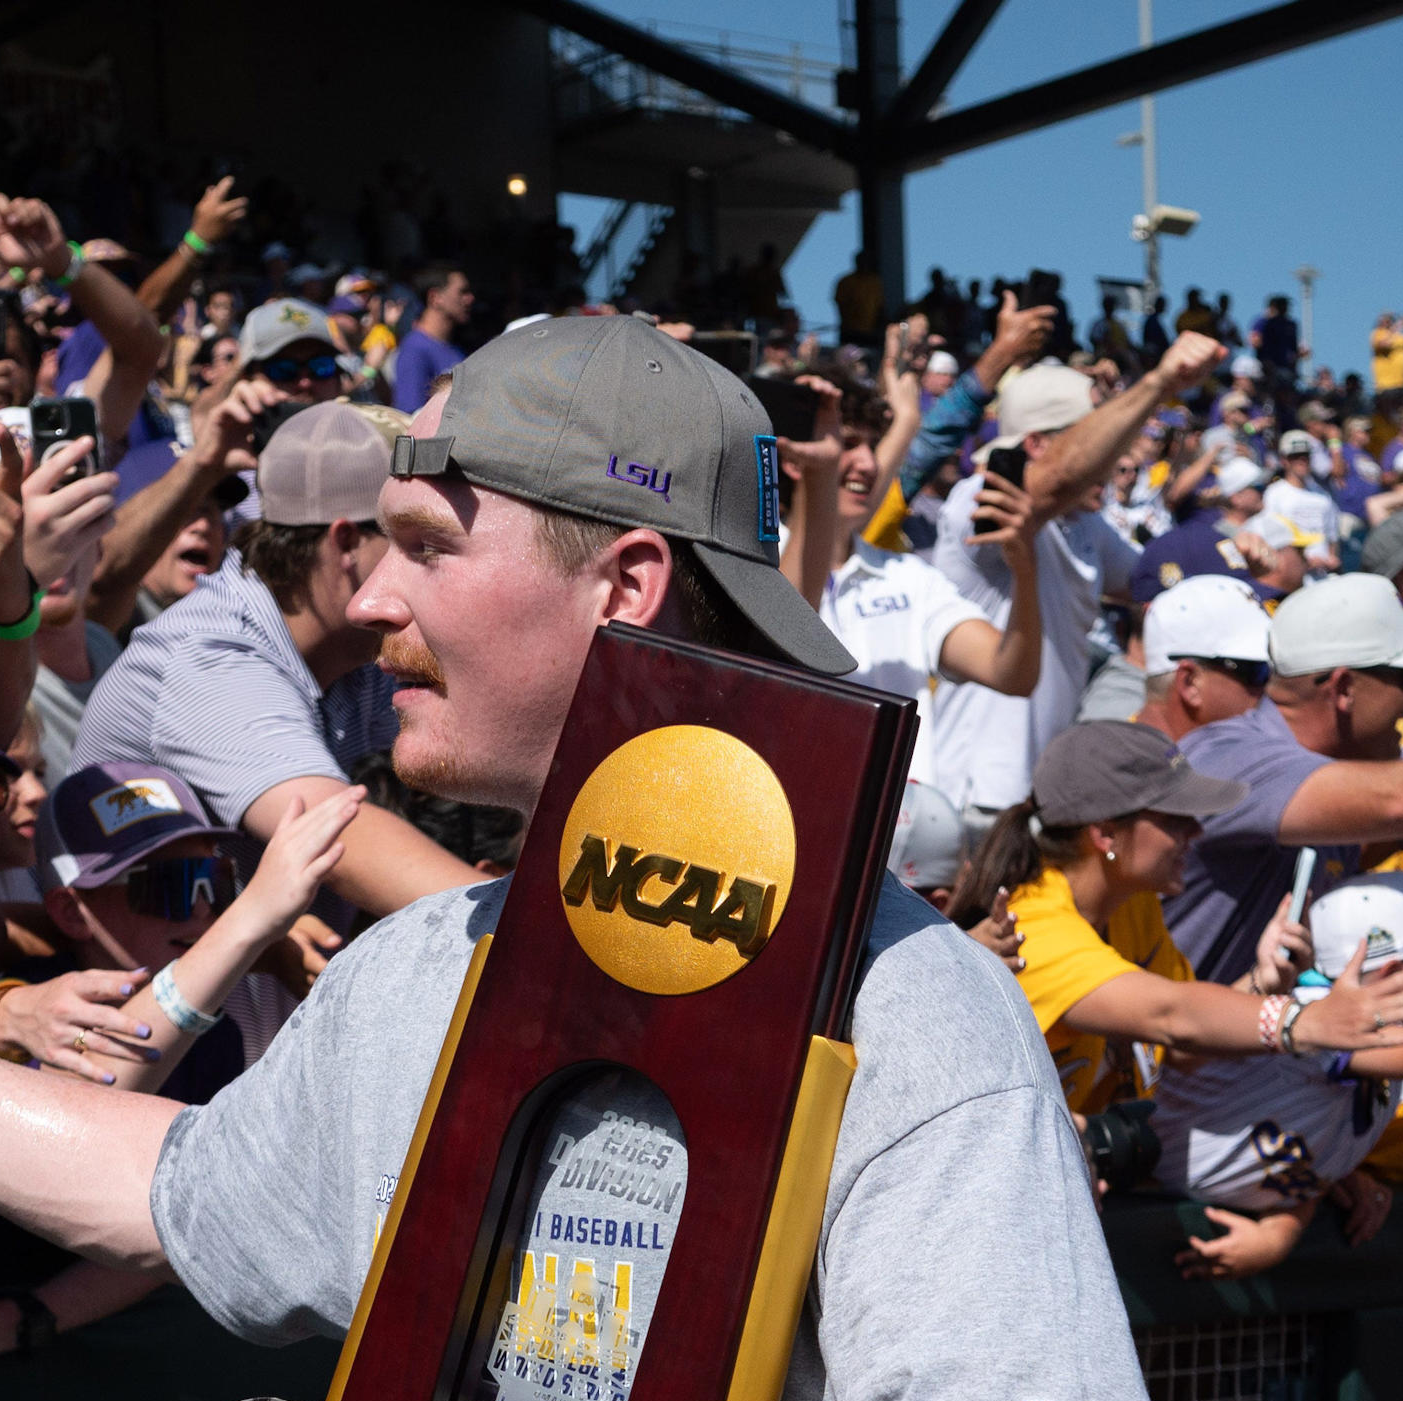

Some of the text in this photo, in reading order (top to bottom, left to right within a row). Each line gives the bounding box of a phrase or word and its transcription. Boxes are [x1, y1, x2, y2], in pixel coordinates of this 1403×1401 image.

[606, 453, 672, 503] LSU
[562, 833, 777, 960] NCAA
[550, 1214, 664, 1249] BASEBALL
